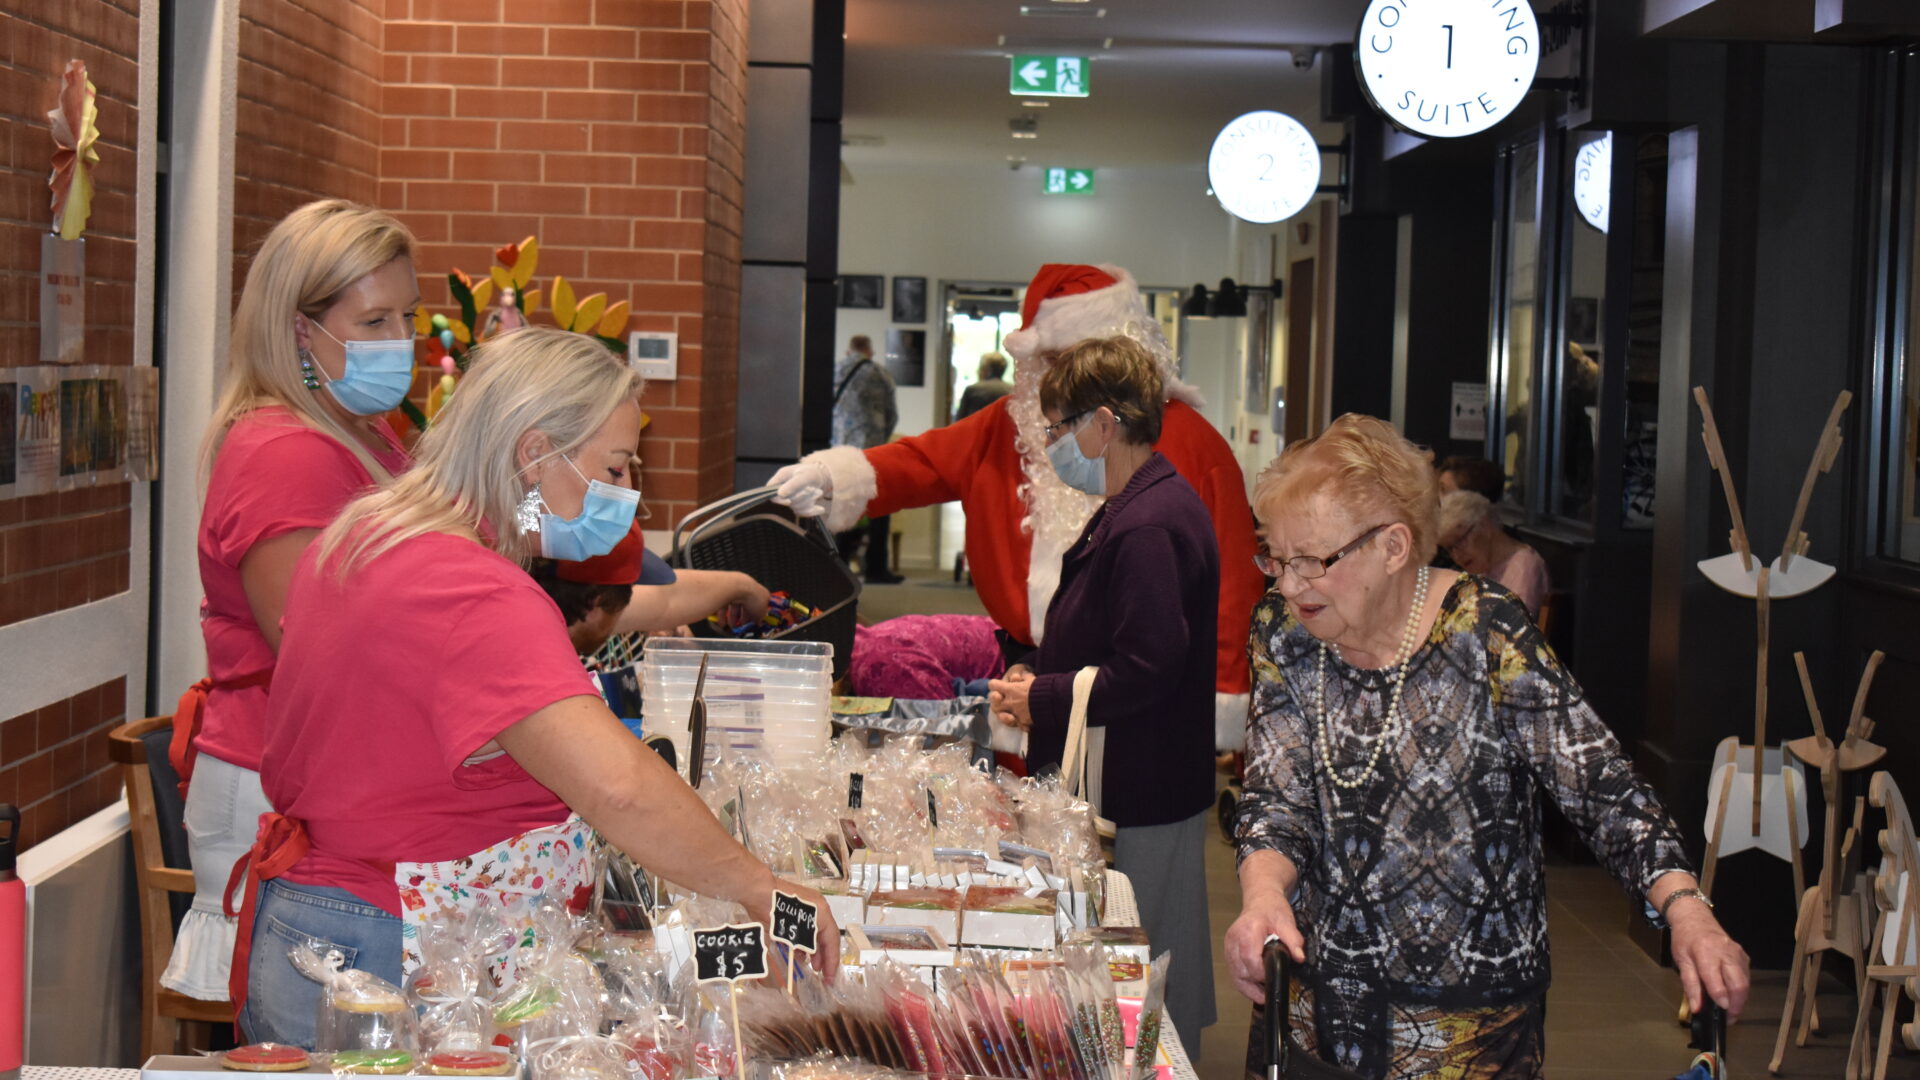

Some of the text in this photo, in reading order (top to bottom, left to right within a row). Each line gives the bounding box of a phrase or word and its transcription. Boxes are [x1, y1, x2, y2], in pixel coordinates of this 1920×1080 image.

[1440, 24, 1454, 69] 1
[1397, 91, 1498, 126] SUITE
[1215, 119, 1313, 173] CONSULTING
[1257, 152, 1275, 182] 2
[697, 931, 756, 948] COOKIE
